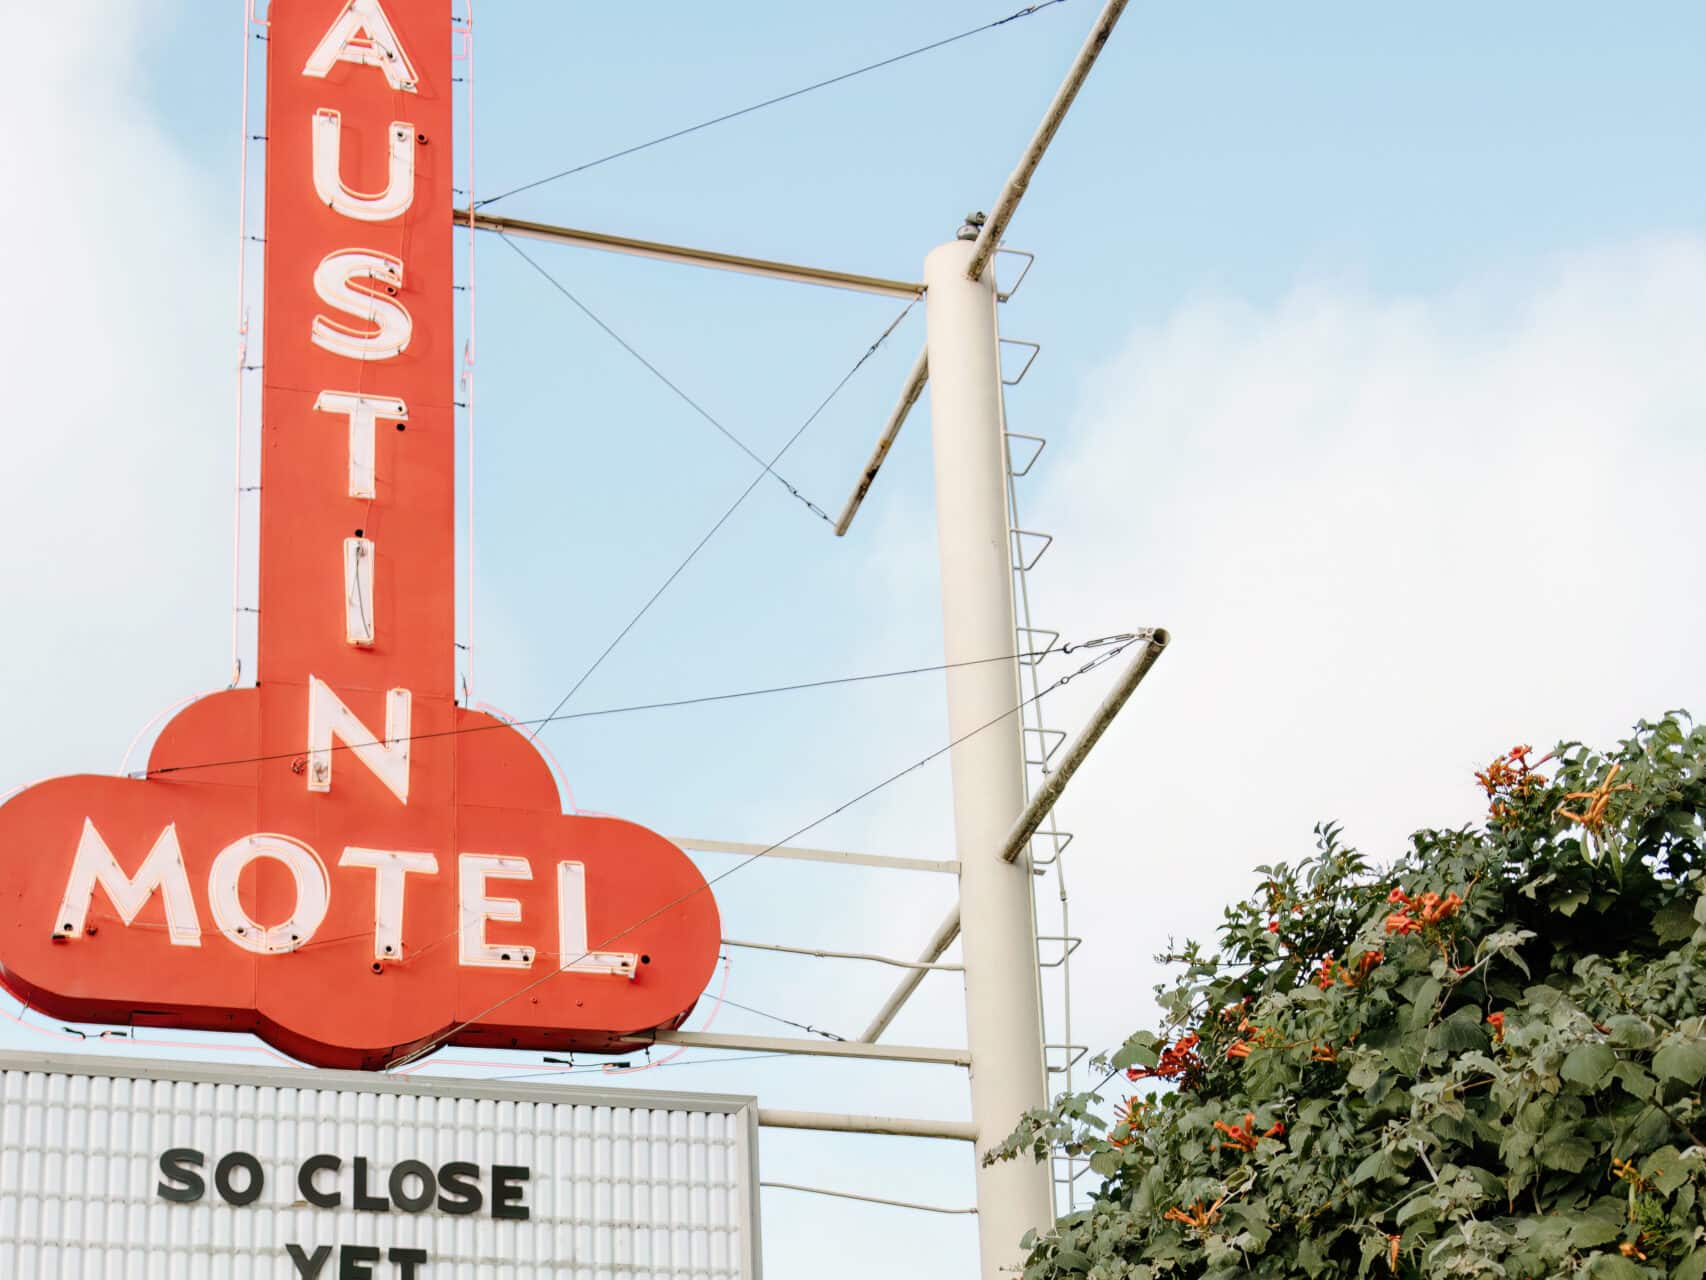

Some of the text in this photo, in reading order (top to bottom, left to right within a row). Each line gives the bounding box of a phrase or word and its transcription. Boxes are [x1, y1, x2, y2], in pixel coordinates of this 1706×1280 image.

[302, 0, 419, 805] AUSTIN
[53, 816, 638, 979] MOTEL
[157, 1148, 530, 1221] SO CLOSE
